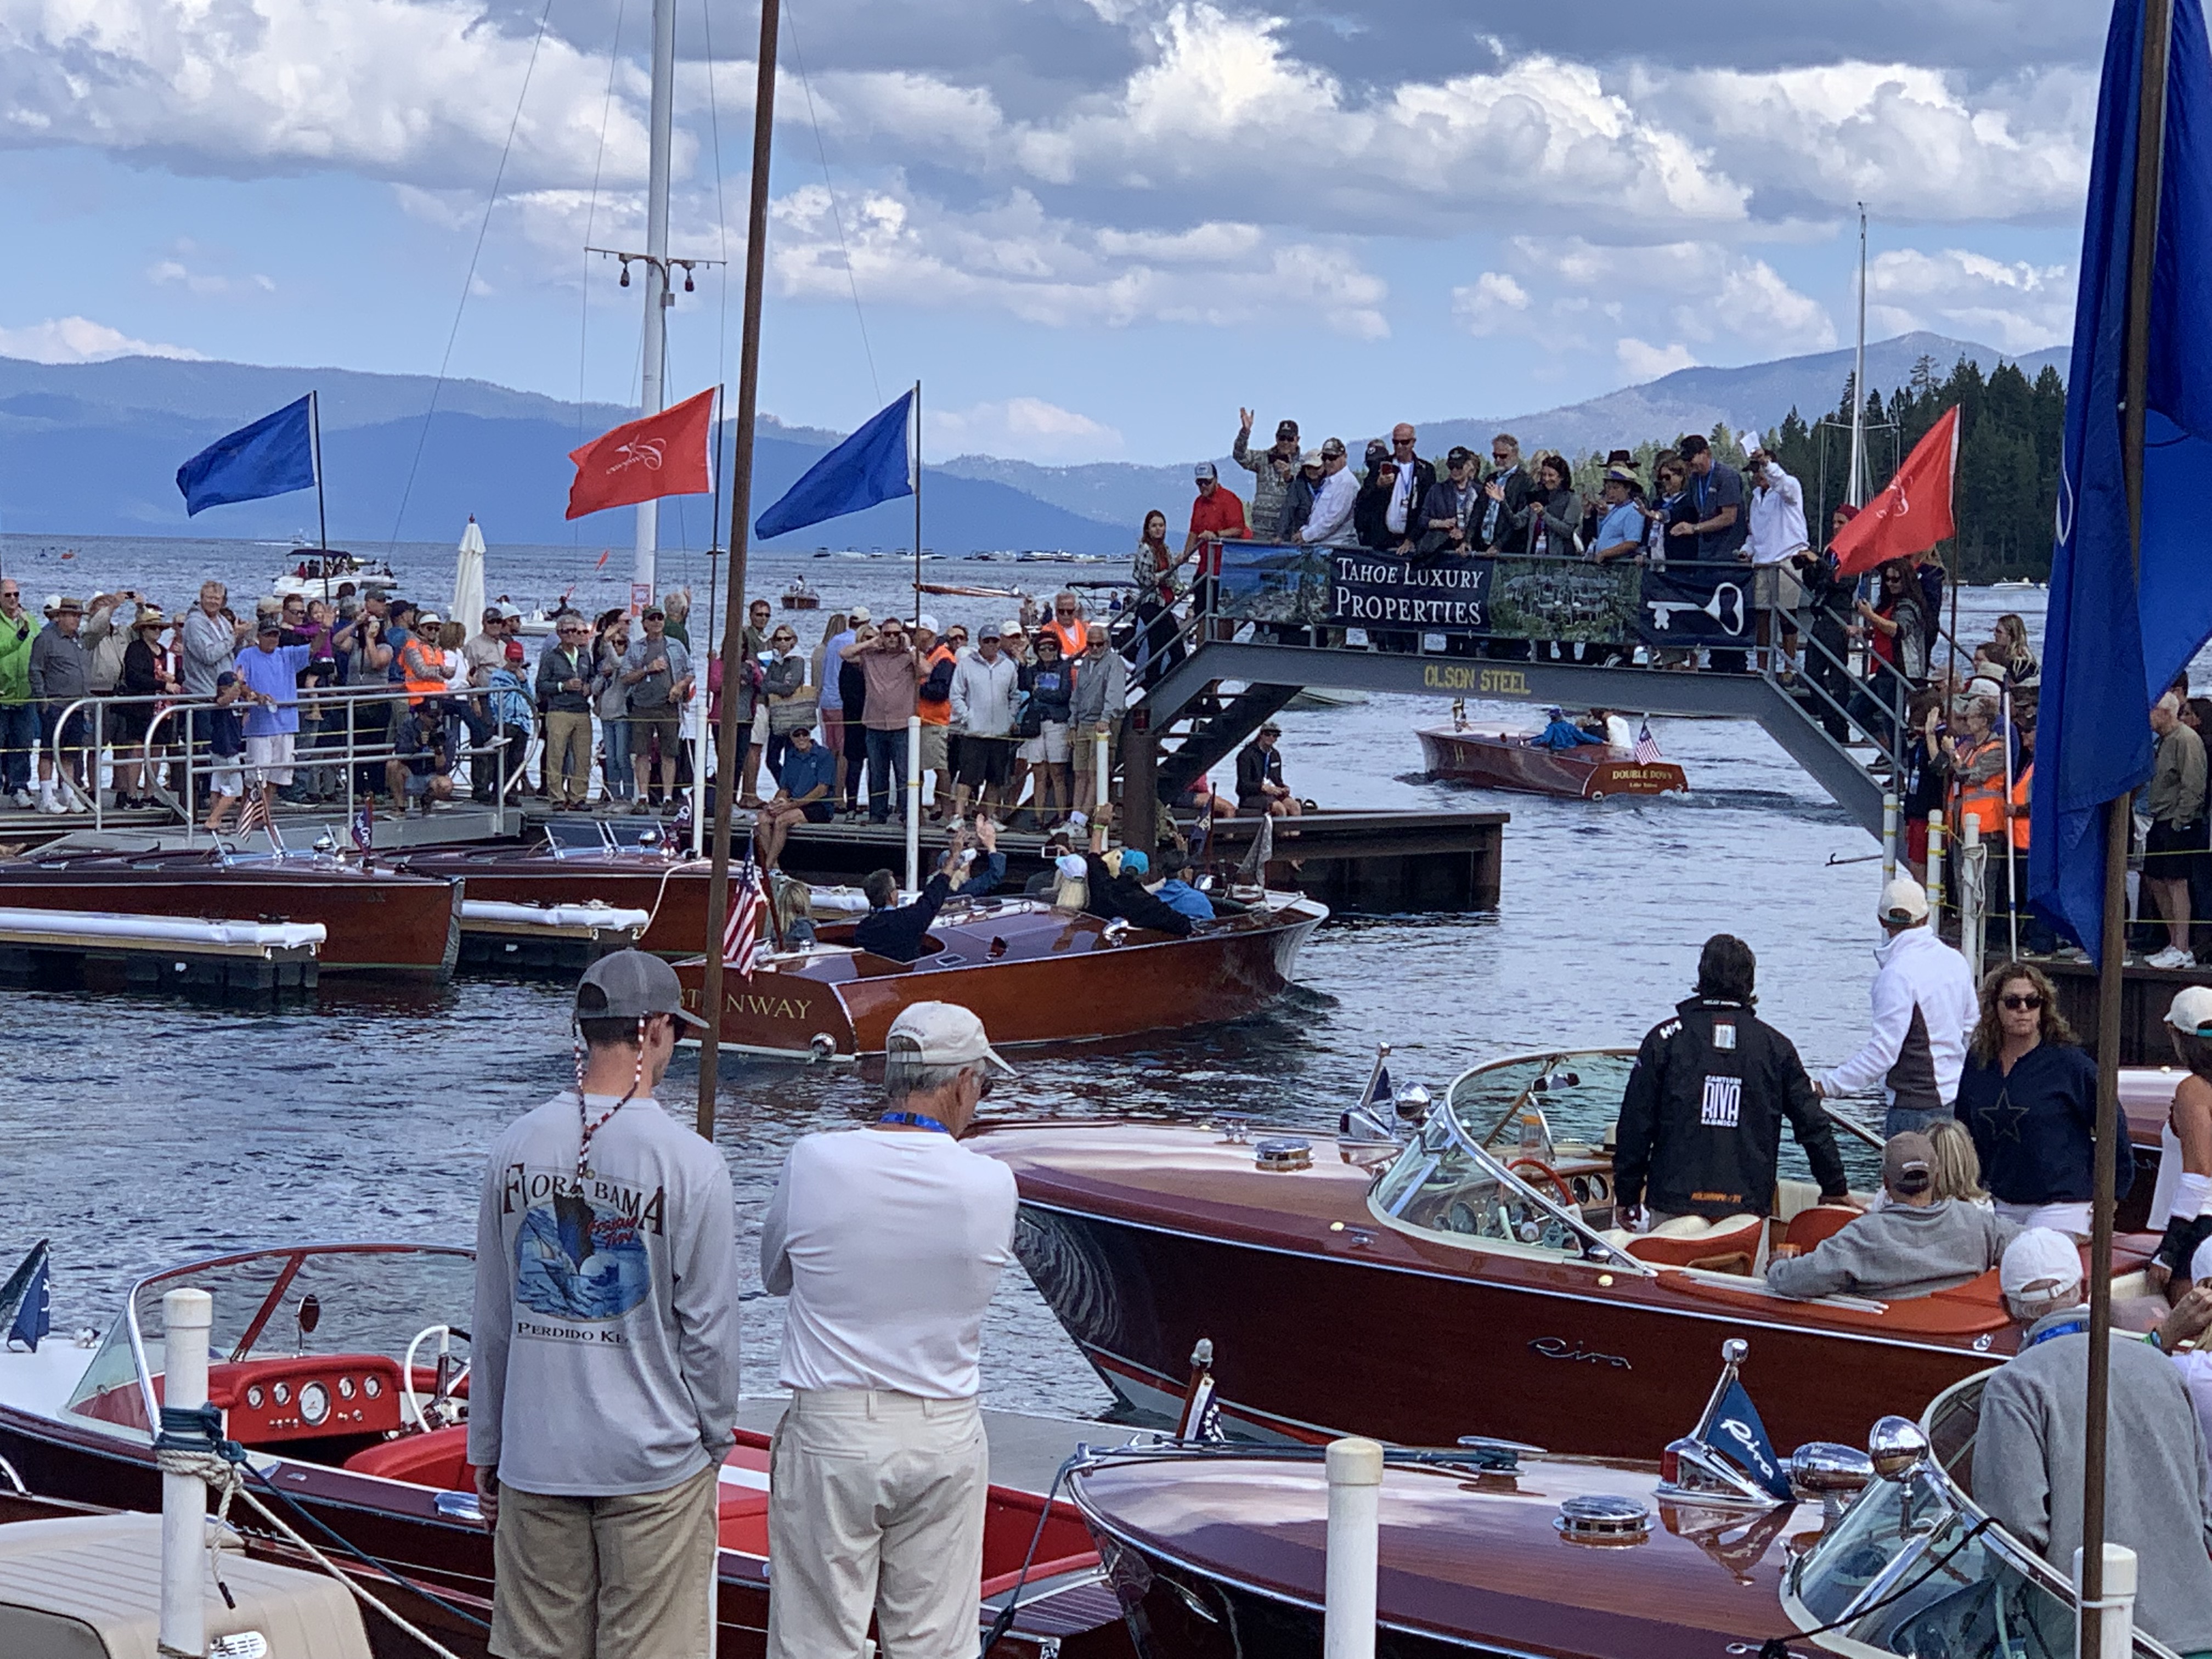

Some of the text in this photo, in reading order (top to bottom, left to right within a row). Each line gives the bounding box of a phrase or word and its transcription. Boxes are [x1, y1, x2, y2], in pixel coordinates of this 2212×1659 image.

[1336, 557, 1483, 589] TAHOE LUXURY
[1335, 585, 1481, 625] PROPERTIES
[1425, 665, 1531, 695] OLSON STEEL
[1612, 770, 1648, 779] DOUBLE
[592, 928, 599, 940] 3
[631, 927, 641, 940] 2
[680, 989, 812, 1019] TNWAY
[1702, 1082, 1741, 1121] RIVA
[518, 1322, 628, 1344] PERDIDO KE
[1720, 1419, 1774, 1480] Riva
